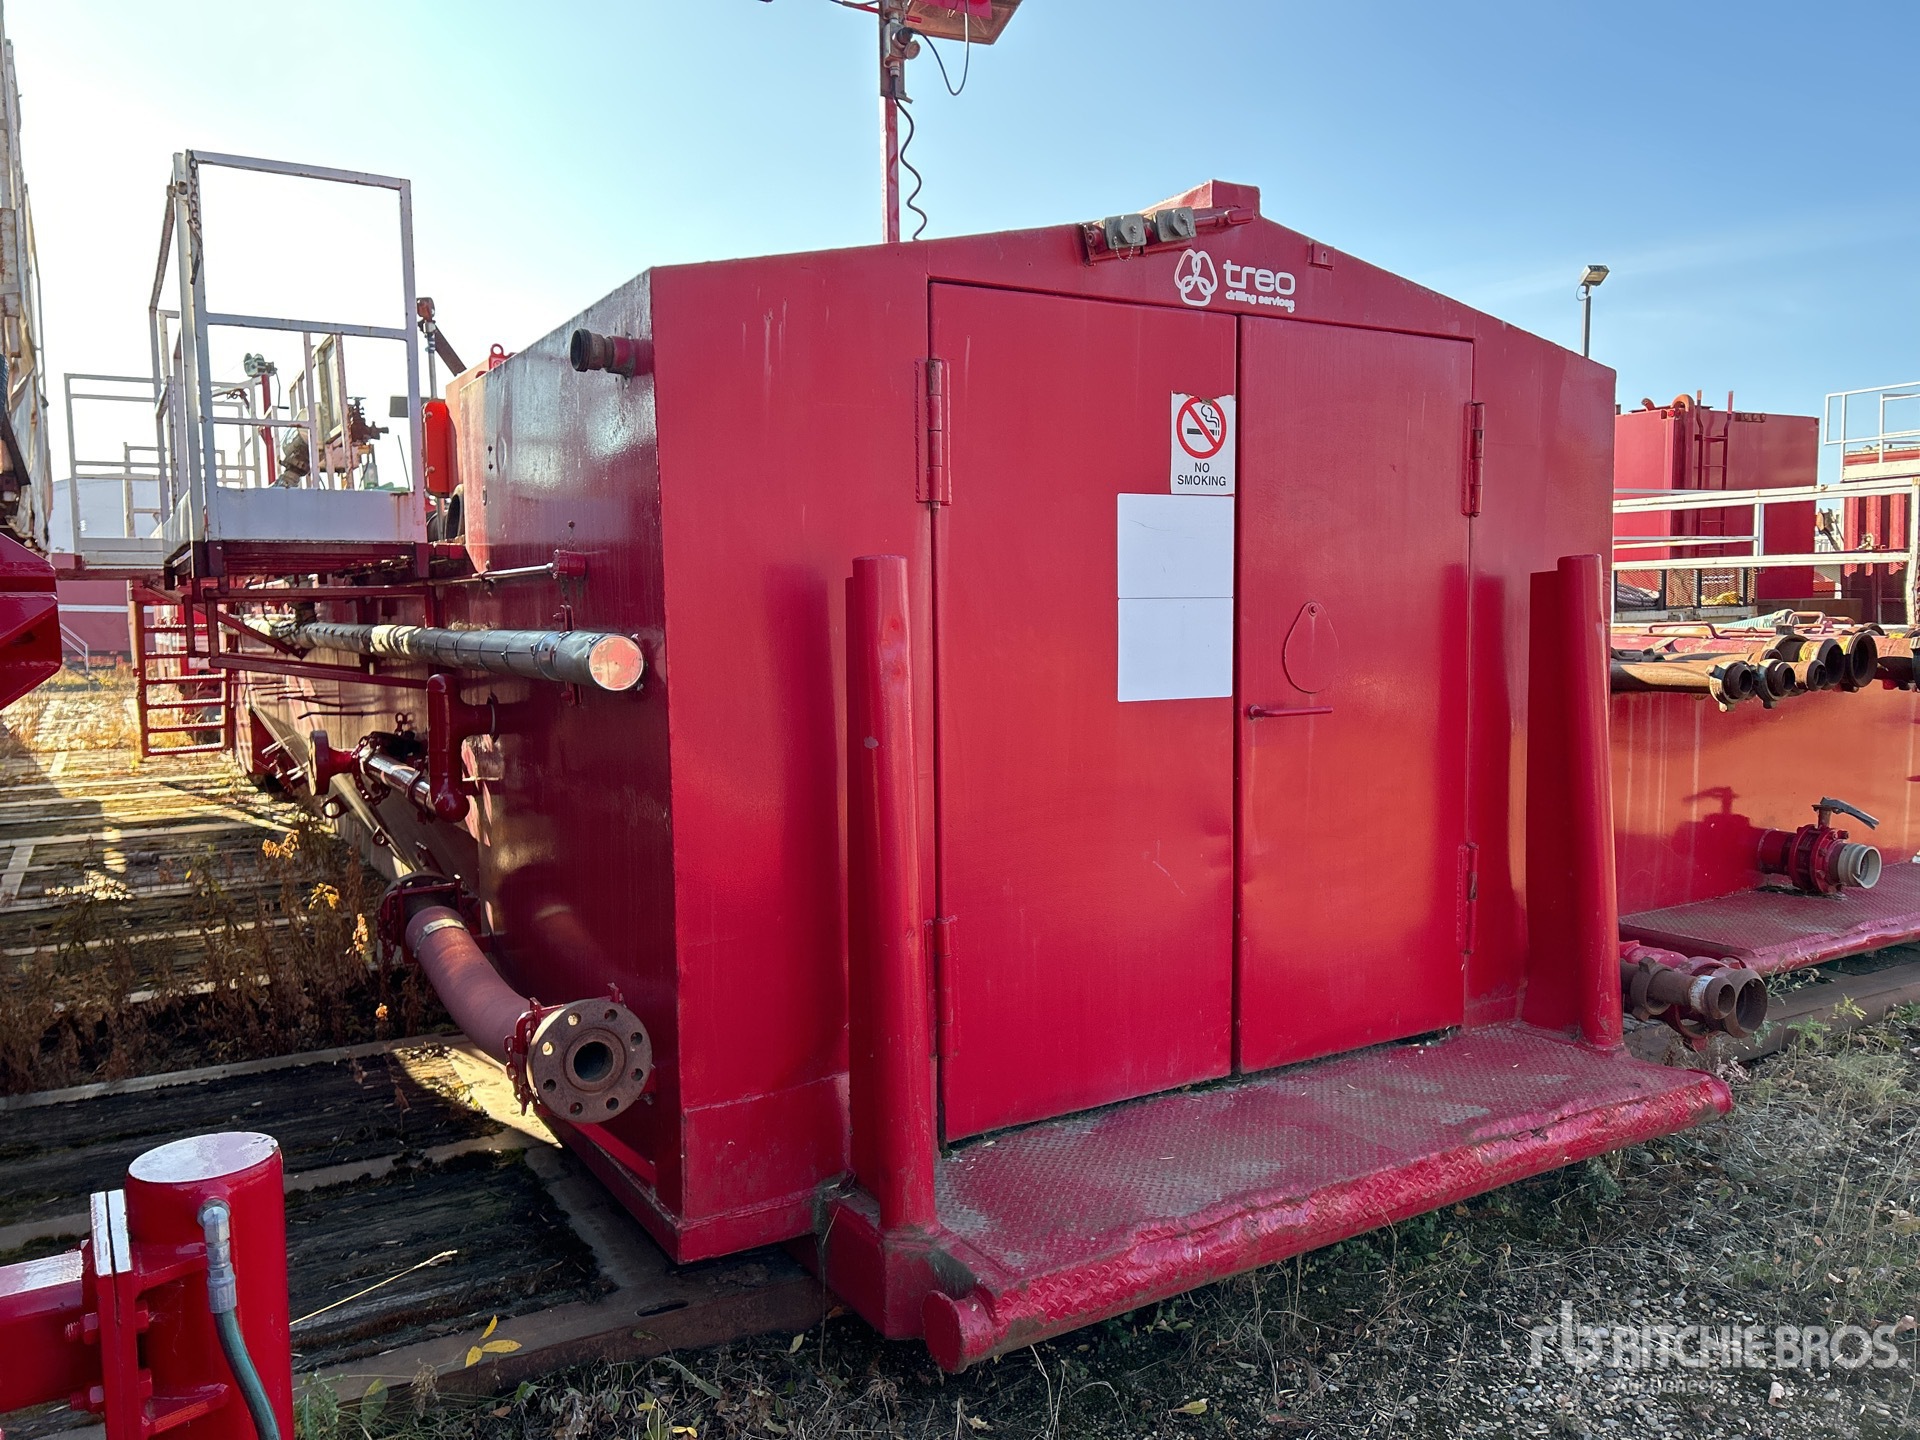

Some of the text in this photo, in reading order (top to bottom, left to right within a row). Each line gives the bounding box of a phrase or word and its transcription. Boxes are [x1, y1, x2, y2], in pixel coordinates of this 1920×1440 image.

[1222, 259, 1296, 295] treo
[1225, 290, 1257, 305] drilling
[1194, 462, 1210, 473] NO
[1177, 474, 1227, 487] SMOKING
